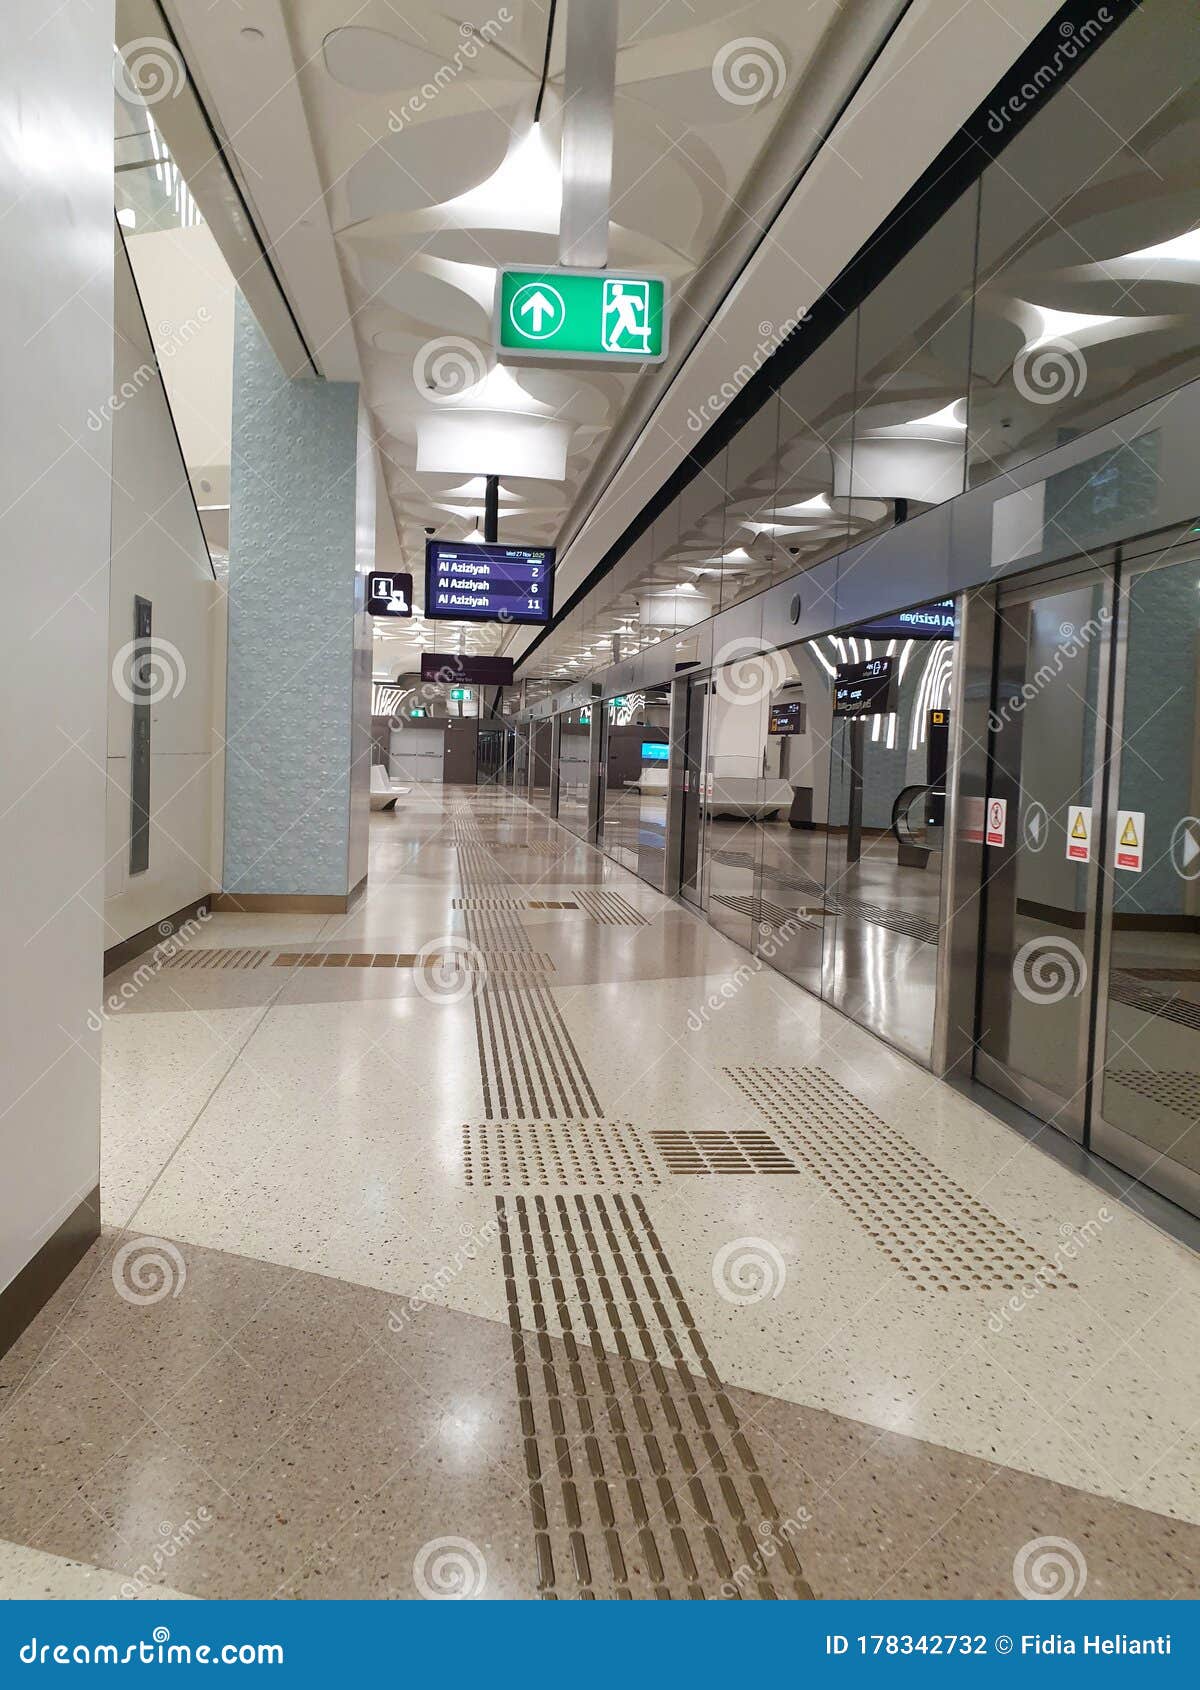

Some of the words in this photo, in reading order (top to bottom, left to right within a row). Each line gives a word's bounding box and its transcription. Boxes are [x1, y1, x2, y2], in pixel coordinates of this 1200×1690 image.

[439, 562, 449, 572] Al
[451, 562, 490, 575] Aziziyah
[532, 568, 539, 577] 2
[439, 578, 449, 587] Al
[450, 579, 490, 591] Aziziyah
[531, 584, 538, 593] 6
[438, 594, 448, 604] Al
[450, 595, 489, 607] Aziziyah
[527, 600, 541, 609] 11
